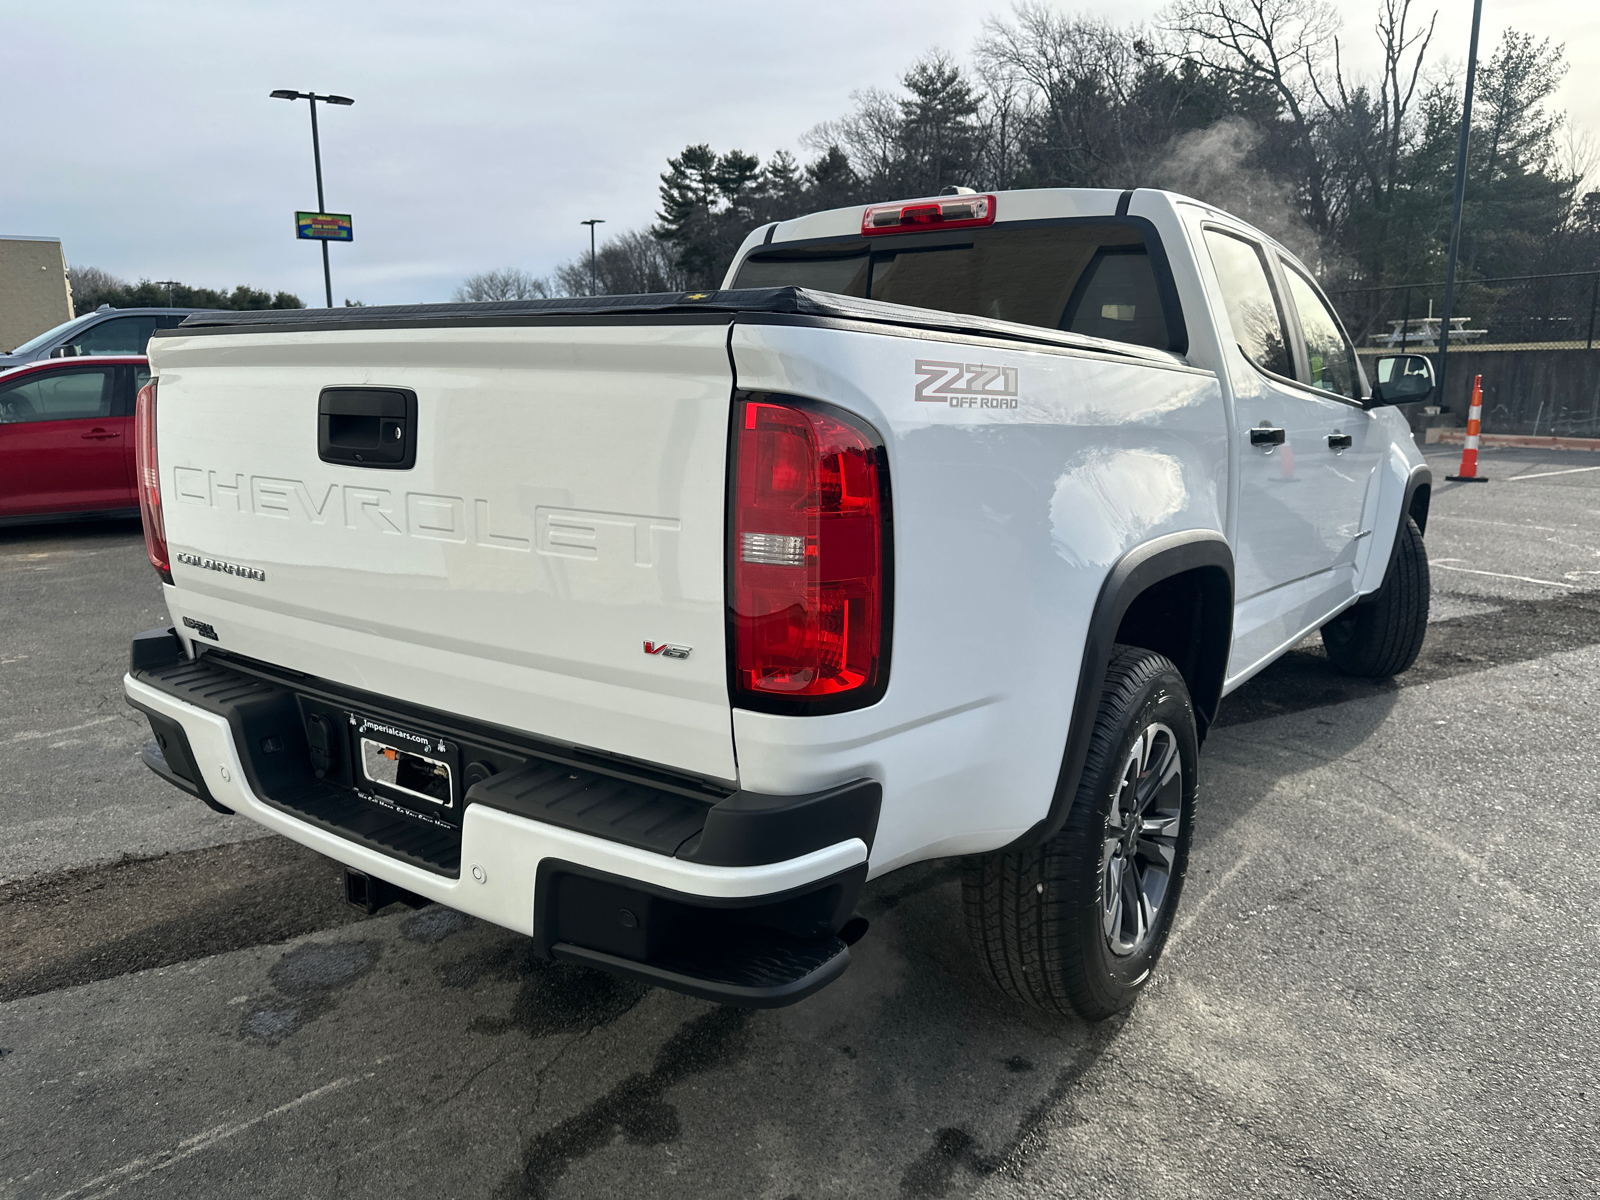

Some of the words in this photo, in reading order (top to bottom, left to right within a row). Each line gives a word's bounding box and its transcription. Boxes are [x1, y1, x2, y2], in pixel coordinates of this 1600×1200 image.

[915, 359, 1018, 402] Z71
[949, 396, 978, 409] OFF
[980, 397, 1018, 410] ROAD
[173, 465, 682, 568] CHEVROLET
[176, 552, 266, 582] COLORADO
[643, 639, 693, 660] V6
[364, 719, 428, 745] Imperialcars.com
